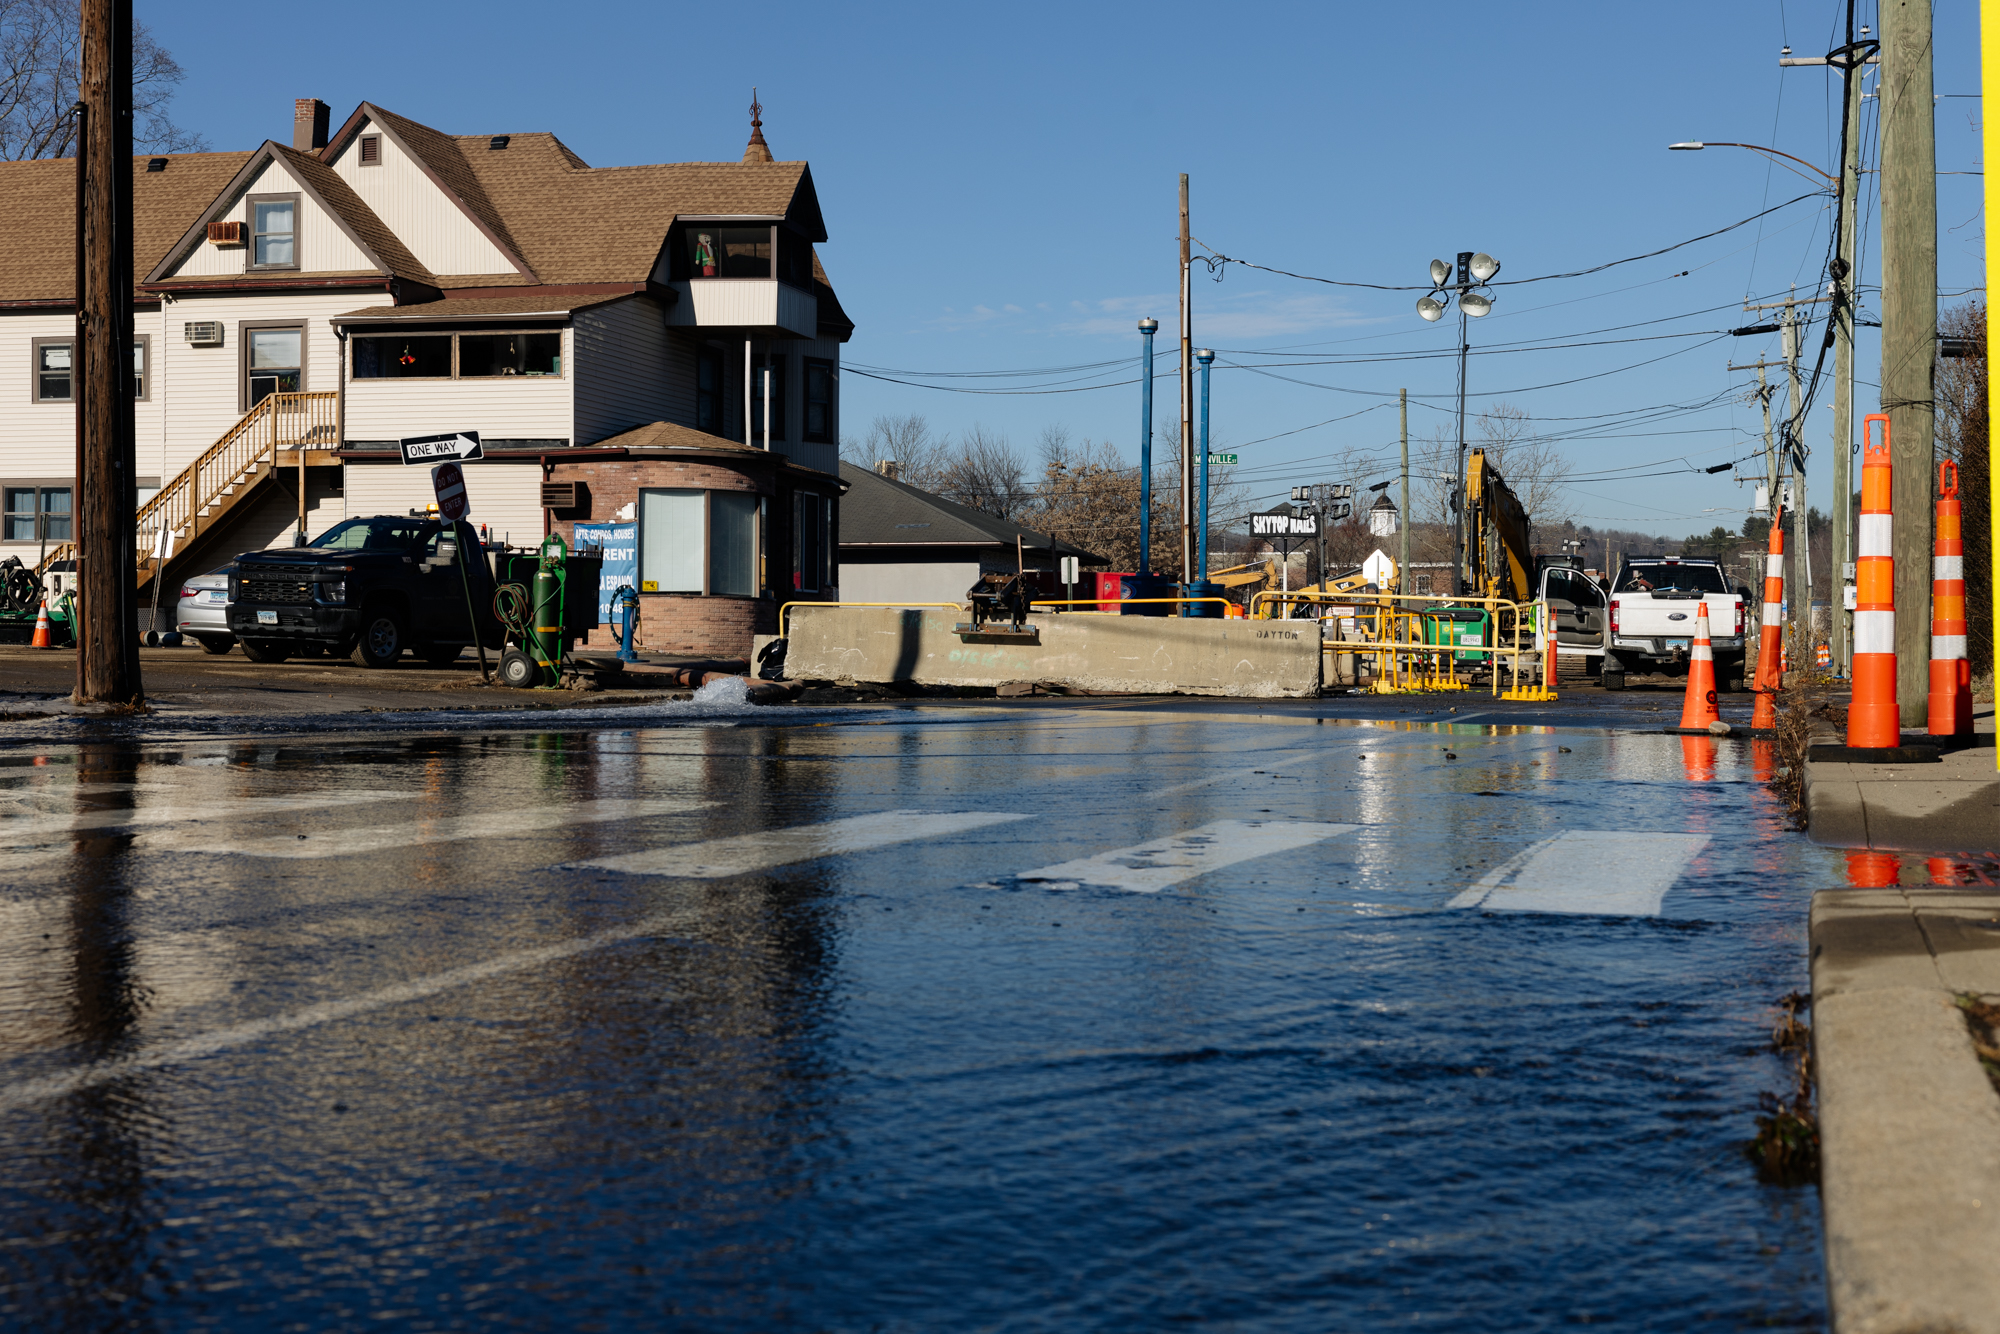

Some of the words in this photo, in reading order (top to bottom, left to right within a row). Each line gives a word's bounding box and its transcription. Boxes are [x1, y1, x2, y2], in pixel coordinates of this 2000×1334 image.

[410, 444, 432, 456] ONE
[434, 441, 456, 454] WAY
[1195, 455, 1232, 464] MNVILLE
[437, 477, 446, 488] DO
[446, 471, 458, 483] NOT
[444, 497, 463, 512] ENTER
[1253, 515, 1289, 534] SKYTOP
[1290, 515, 1316, 534] NAILS
[613, 528, 635, 540] HOUSES
[603, 548, 635, 561] RENT
[1256, 630, 1298, 640] DAYTON
